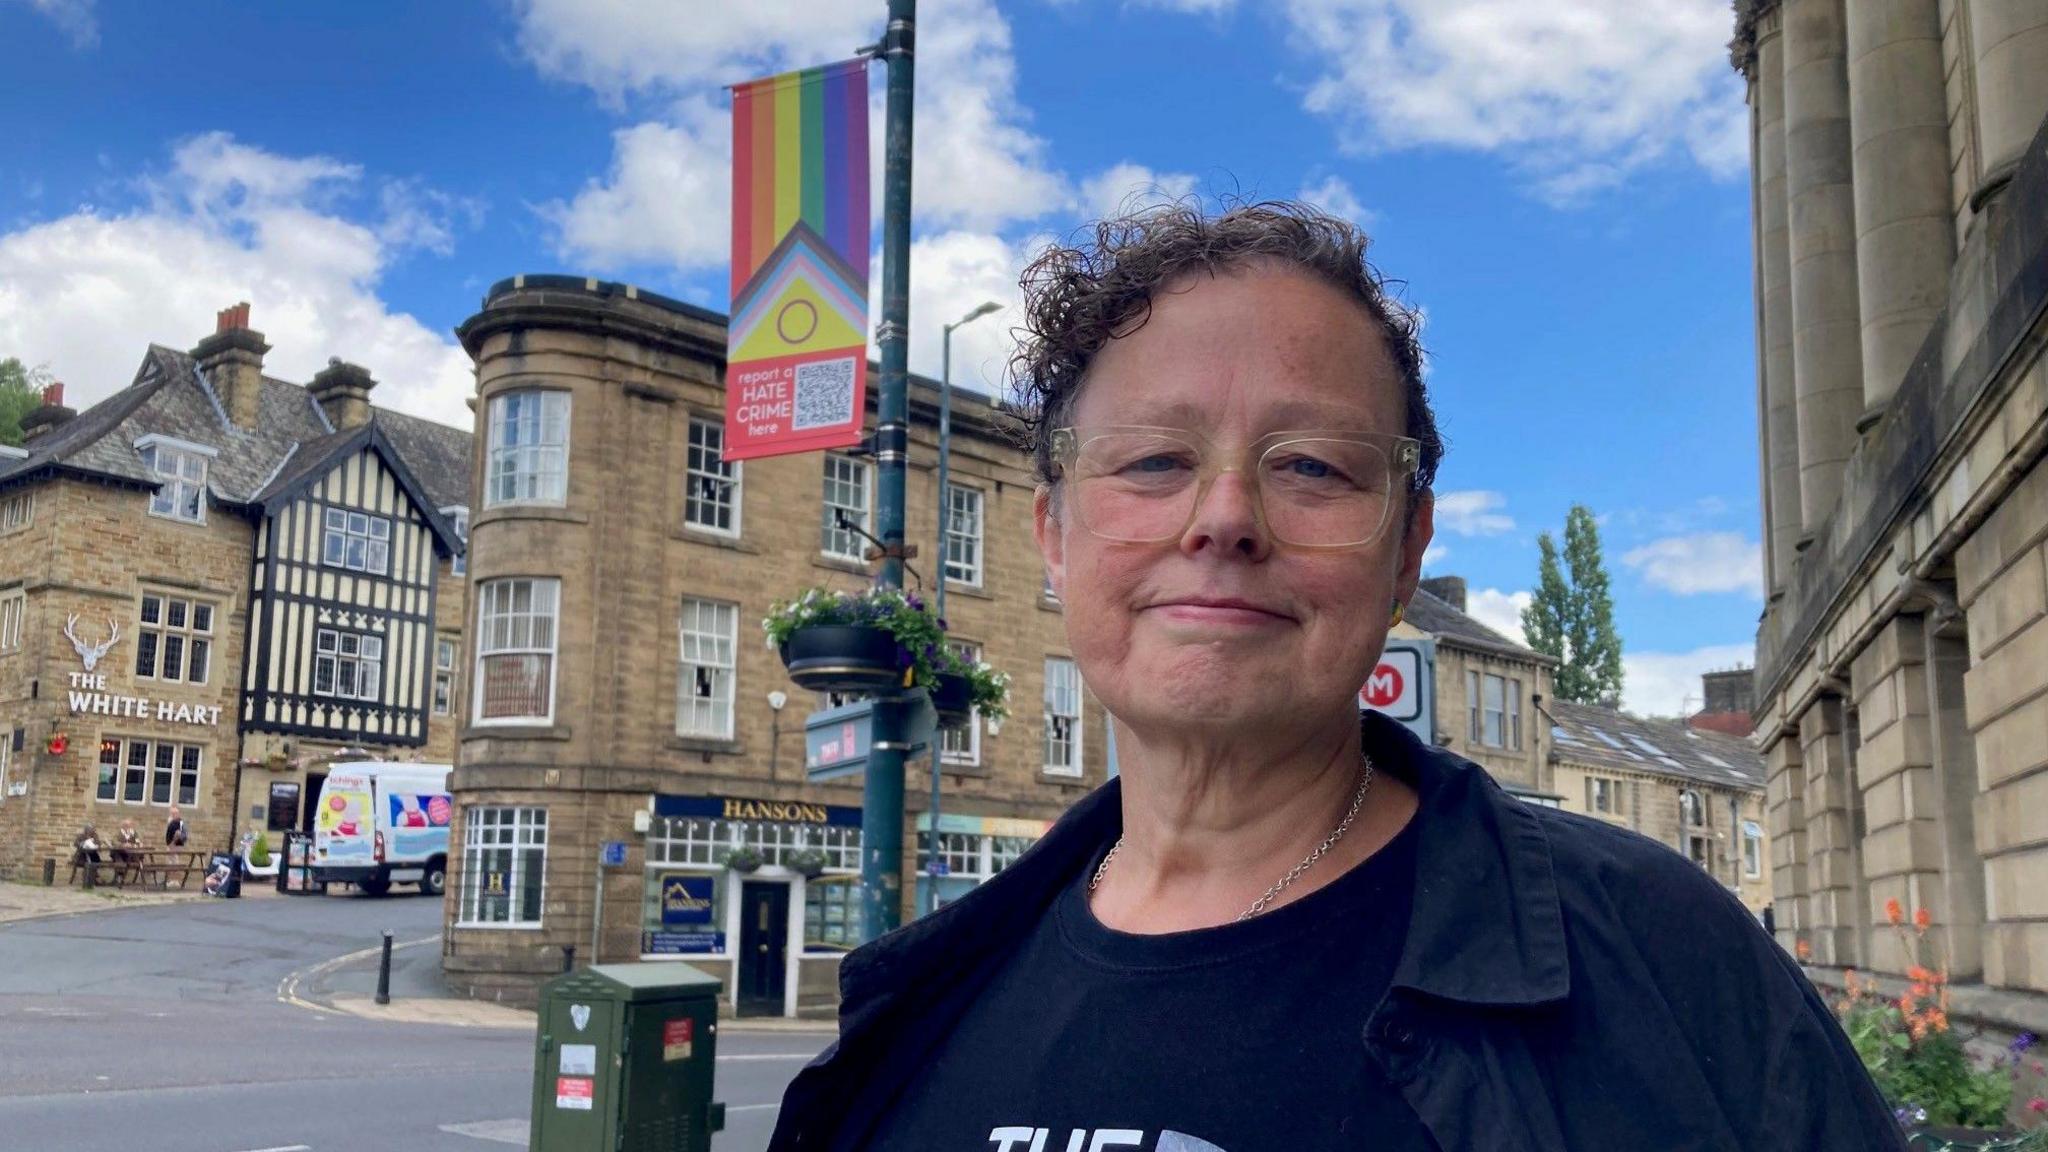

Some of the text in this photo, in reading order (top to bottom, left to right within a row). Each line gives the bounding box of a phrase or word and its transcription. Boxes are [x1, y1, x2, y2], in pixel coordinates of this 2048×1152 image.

[738, 367, 792, 384] report a
[743, 382, 787, 402] HATE
[736, 401, 792, 423] CRIME
[748, 423, 778, 436] here
[69, 672, 106, 690] THE
[1368, 673, 1393, 698] M
[68, 691, 222, 725] WHITE HART
[724, 800, 828, 823] HANSONS
